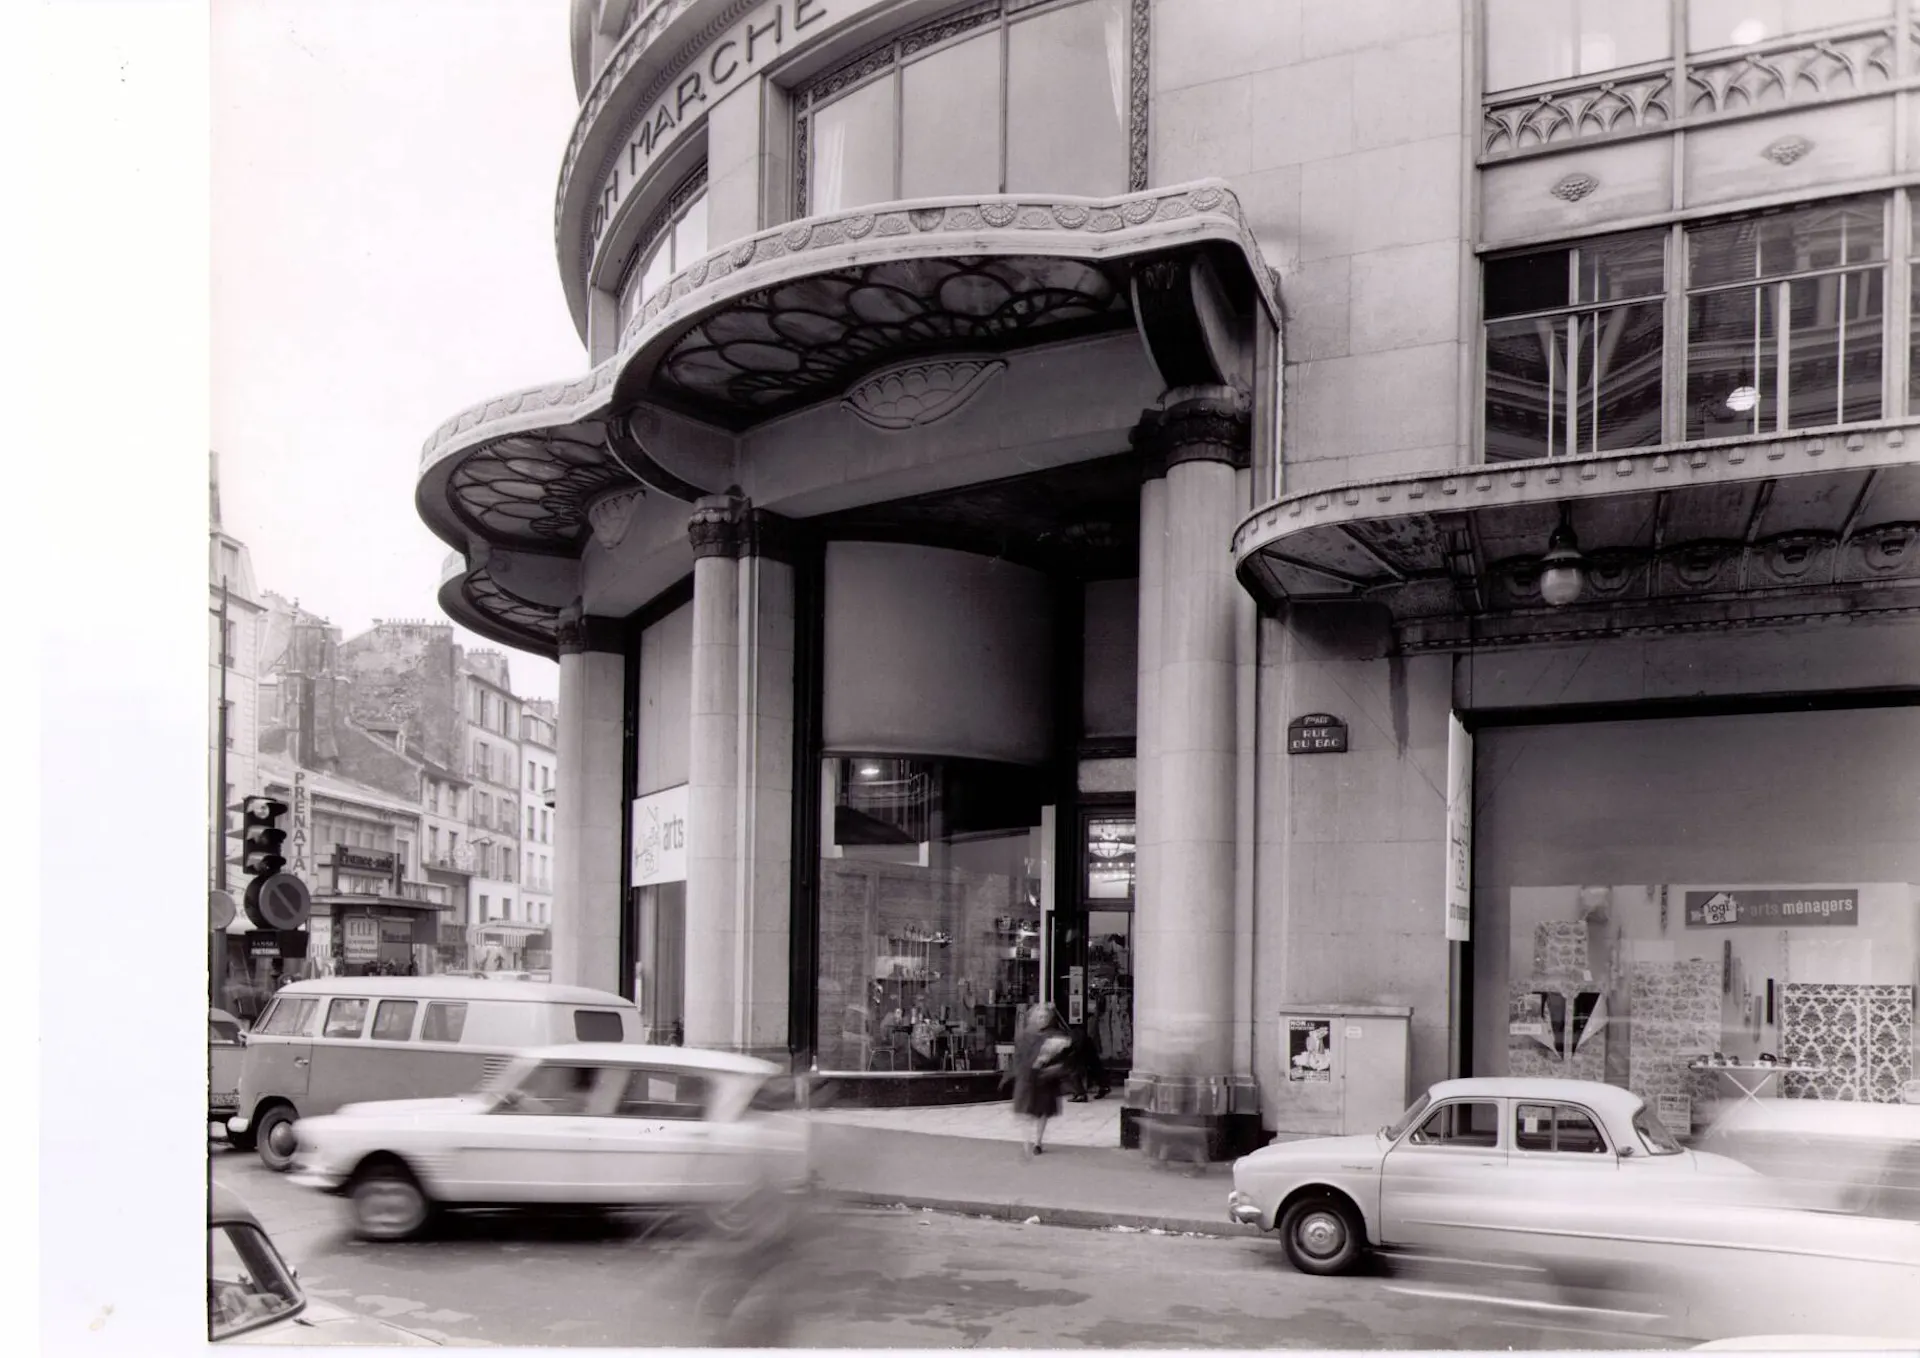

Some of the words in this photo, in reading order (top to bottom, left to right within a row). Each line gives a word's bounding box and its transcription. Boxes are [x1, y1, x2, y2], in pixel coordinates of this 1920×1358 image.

[1303, 728, 1329, 738] RUE
[1293, 739, 1310, 749] DU
[1315, 738, 1340, 748] BAC
[663, 813, 683, 851] arts
[1750, 902, 1779, 917] arts
